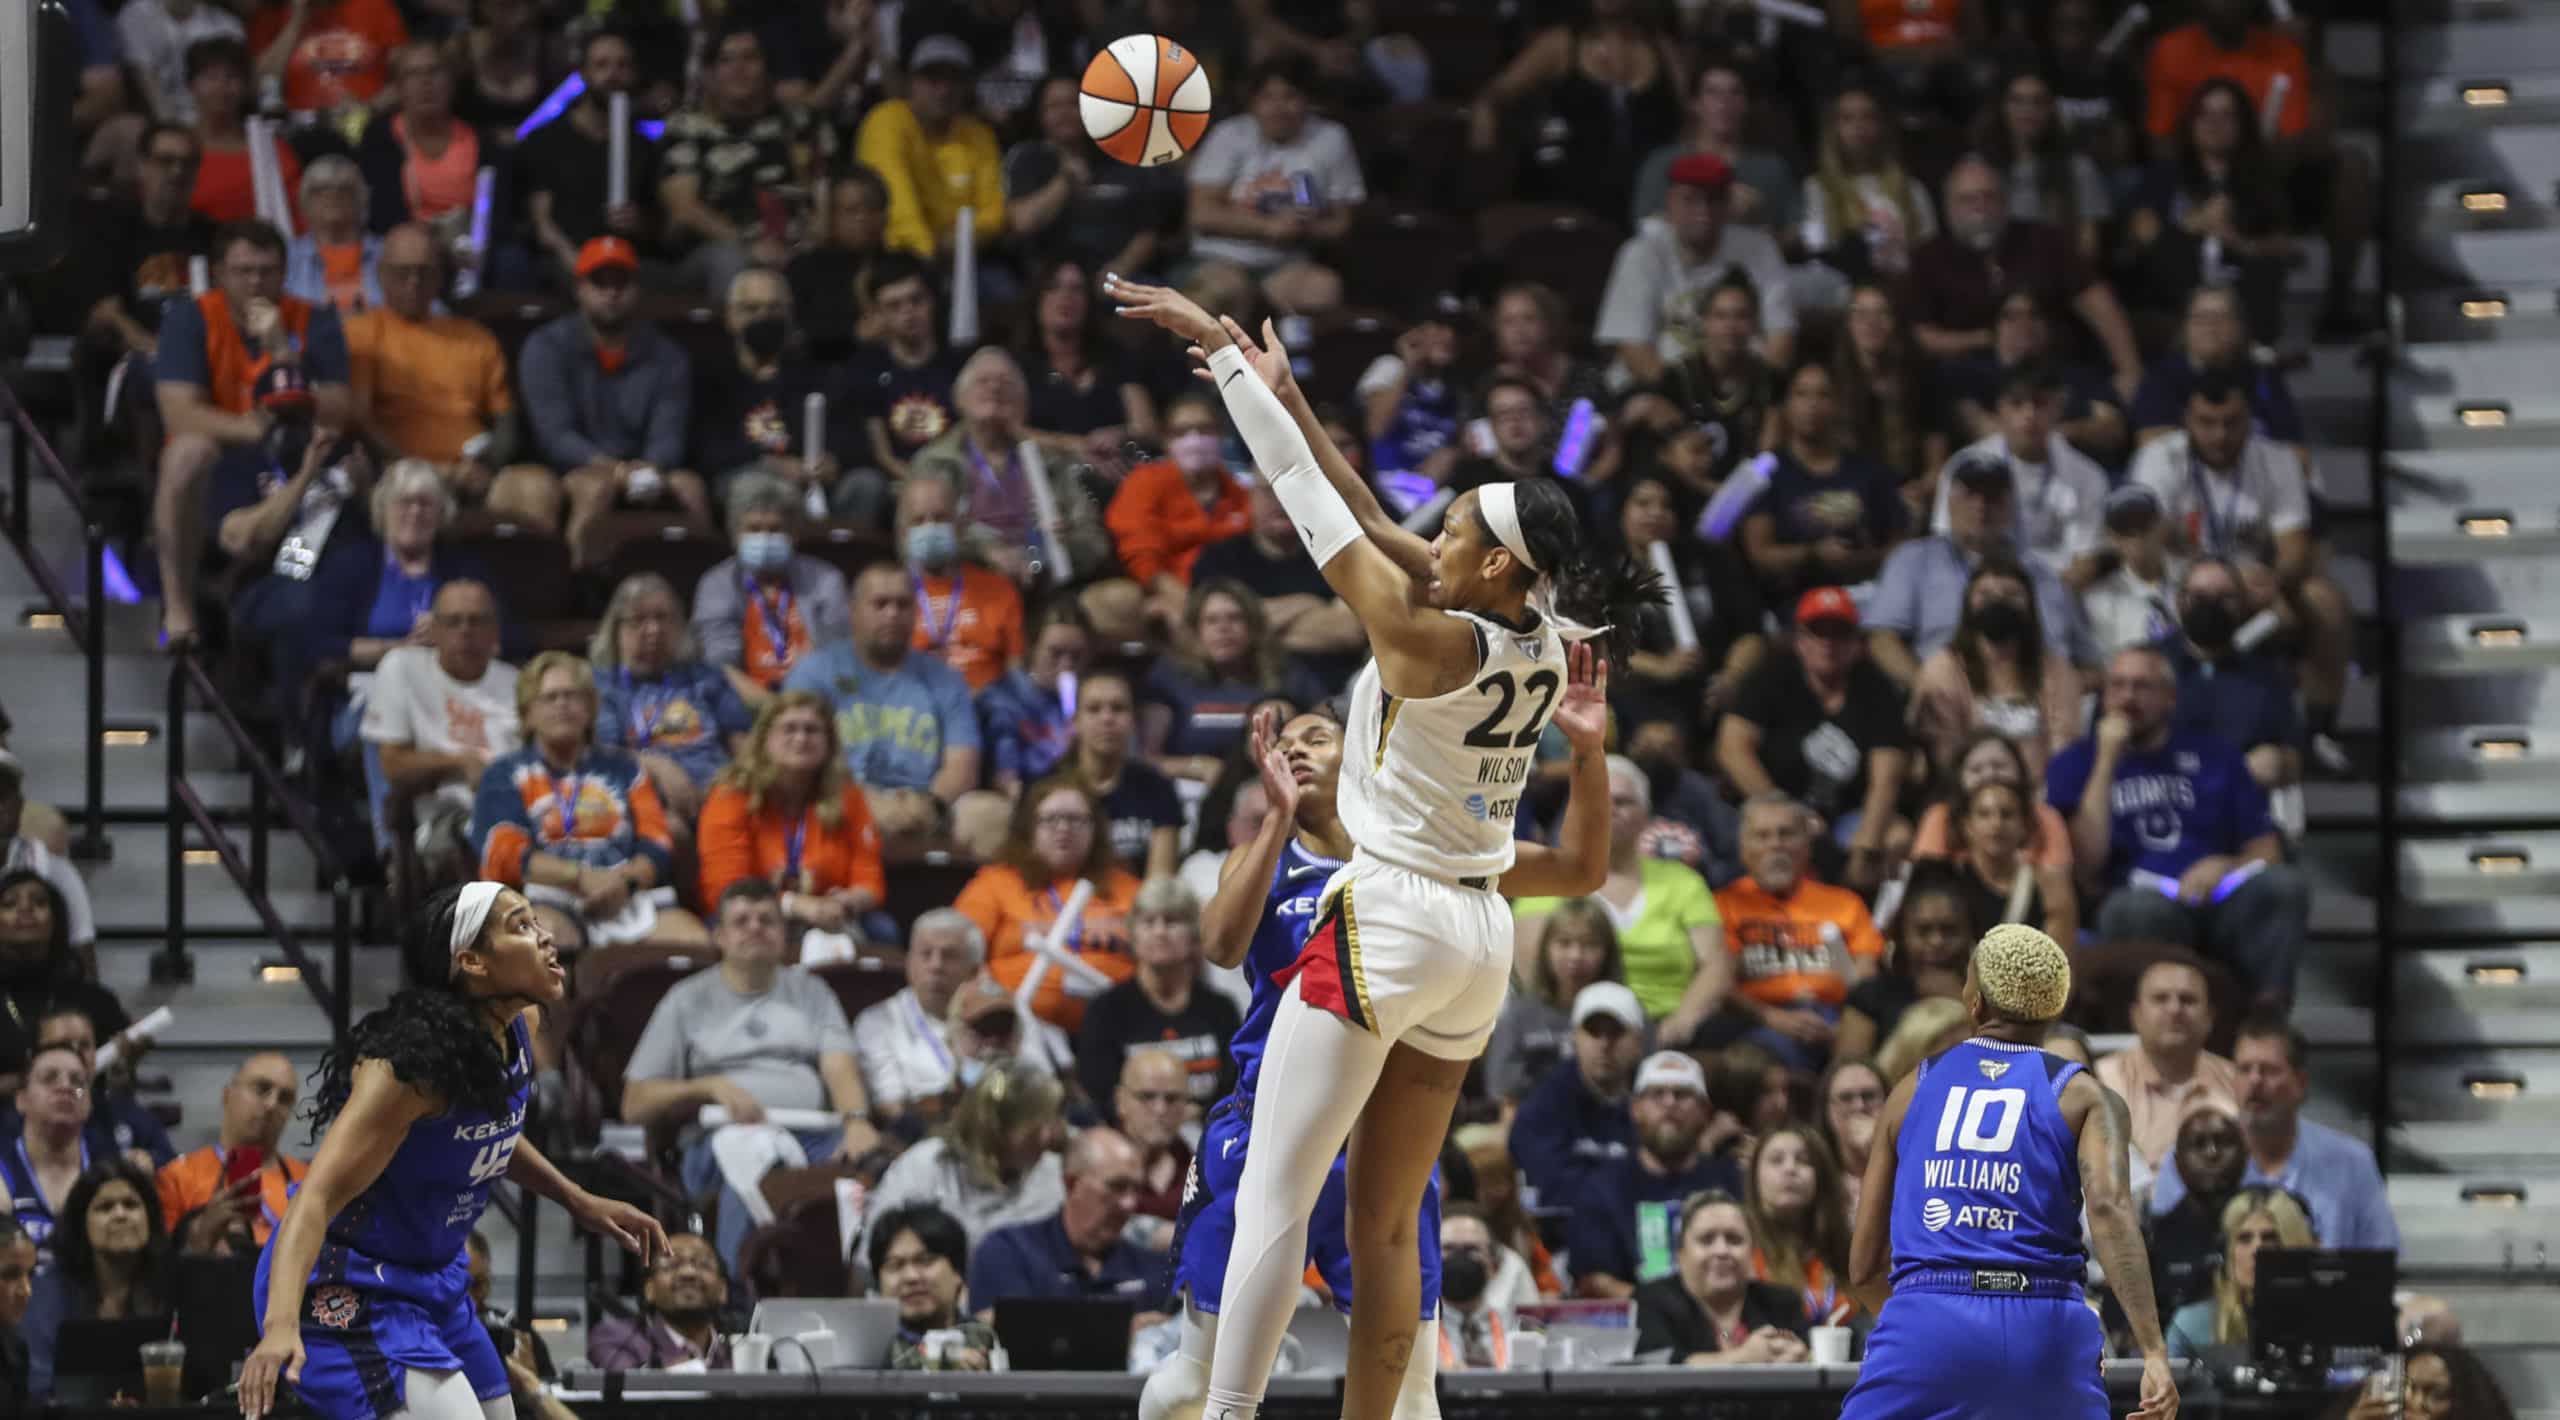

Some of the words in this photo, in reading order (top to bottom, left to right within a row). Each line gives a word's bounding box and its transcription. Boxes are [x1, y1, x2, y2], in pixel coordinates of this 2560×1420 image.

[1464, 669, 1559, 748] 22
[1489, 798, 1517, 820] AT&
[1935, 1086, 2026, 1152] 10
[1924, 1159, 2022, 1194] WILLIAMS
[1954, 1205, 2019, 1232] AT&T
